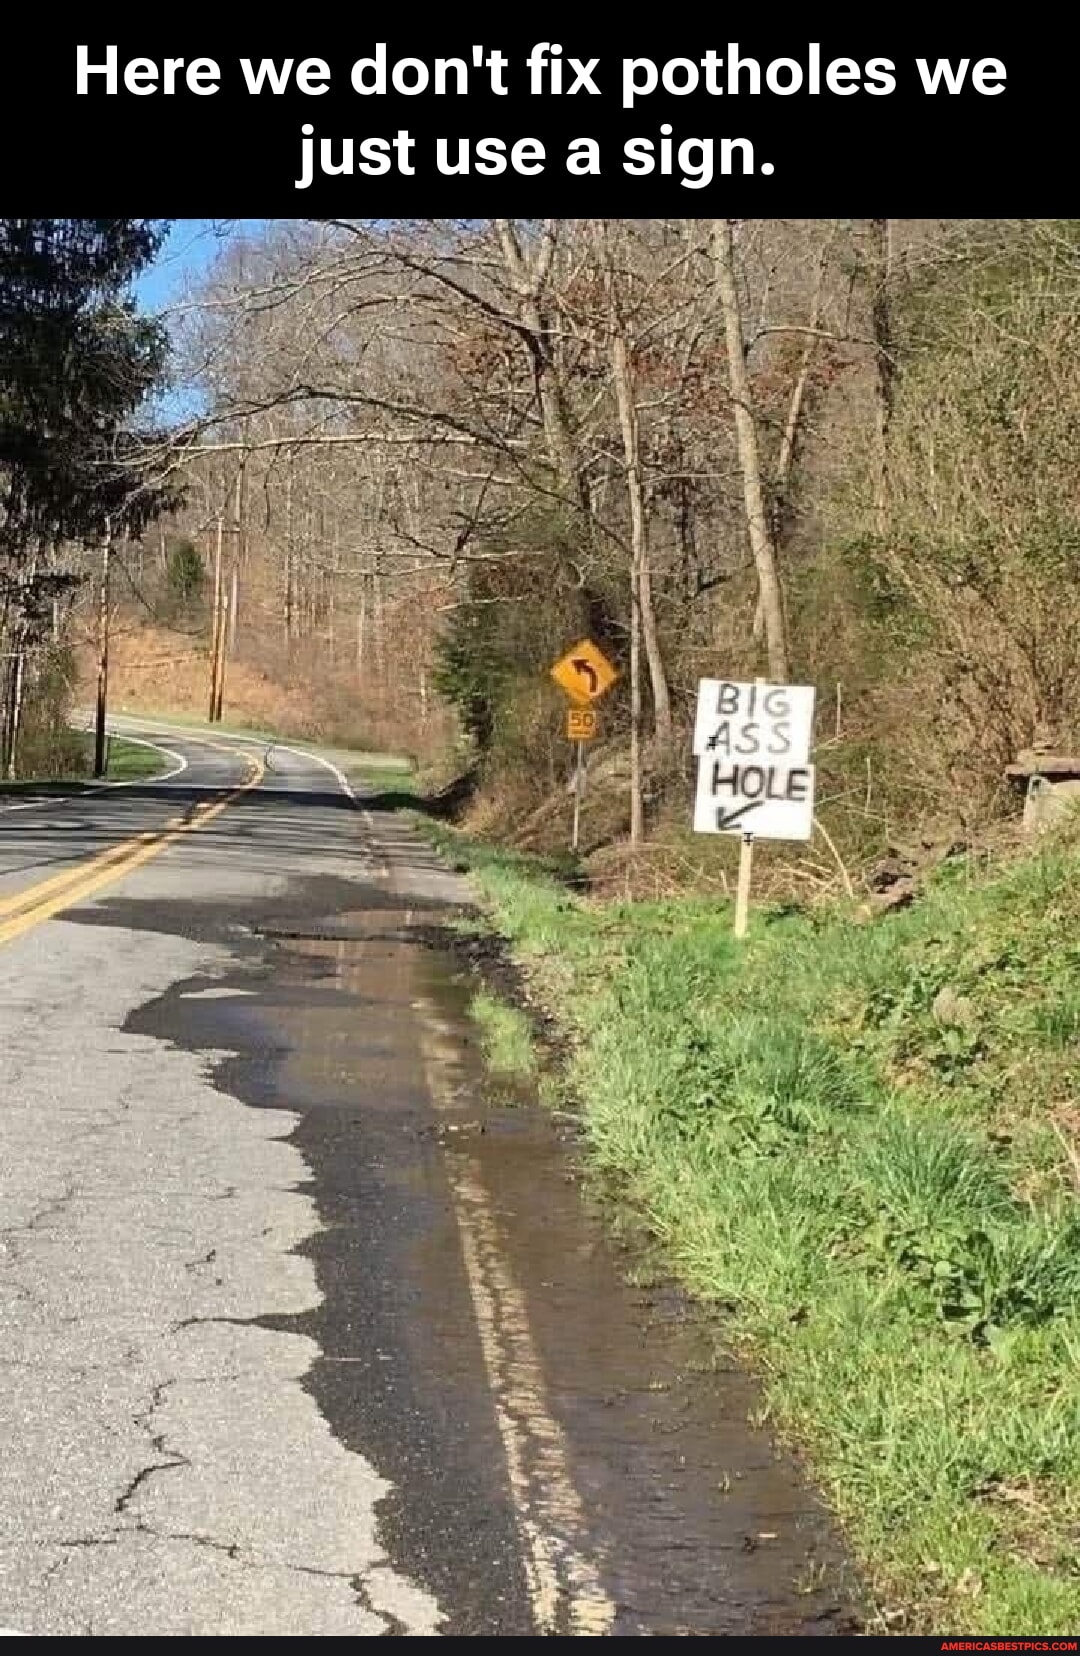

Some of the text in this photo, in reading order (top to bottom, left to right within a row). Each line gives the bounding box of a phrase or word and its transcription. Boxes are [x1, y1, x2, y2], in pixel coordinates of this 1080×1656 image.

[716, 683, 791, 717] BIG
[571, 712, 594, 727] 50
[706, 720, 791, 755] ASS
[711, 761, 808, 802] HOLE
